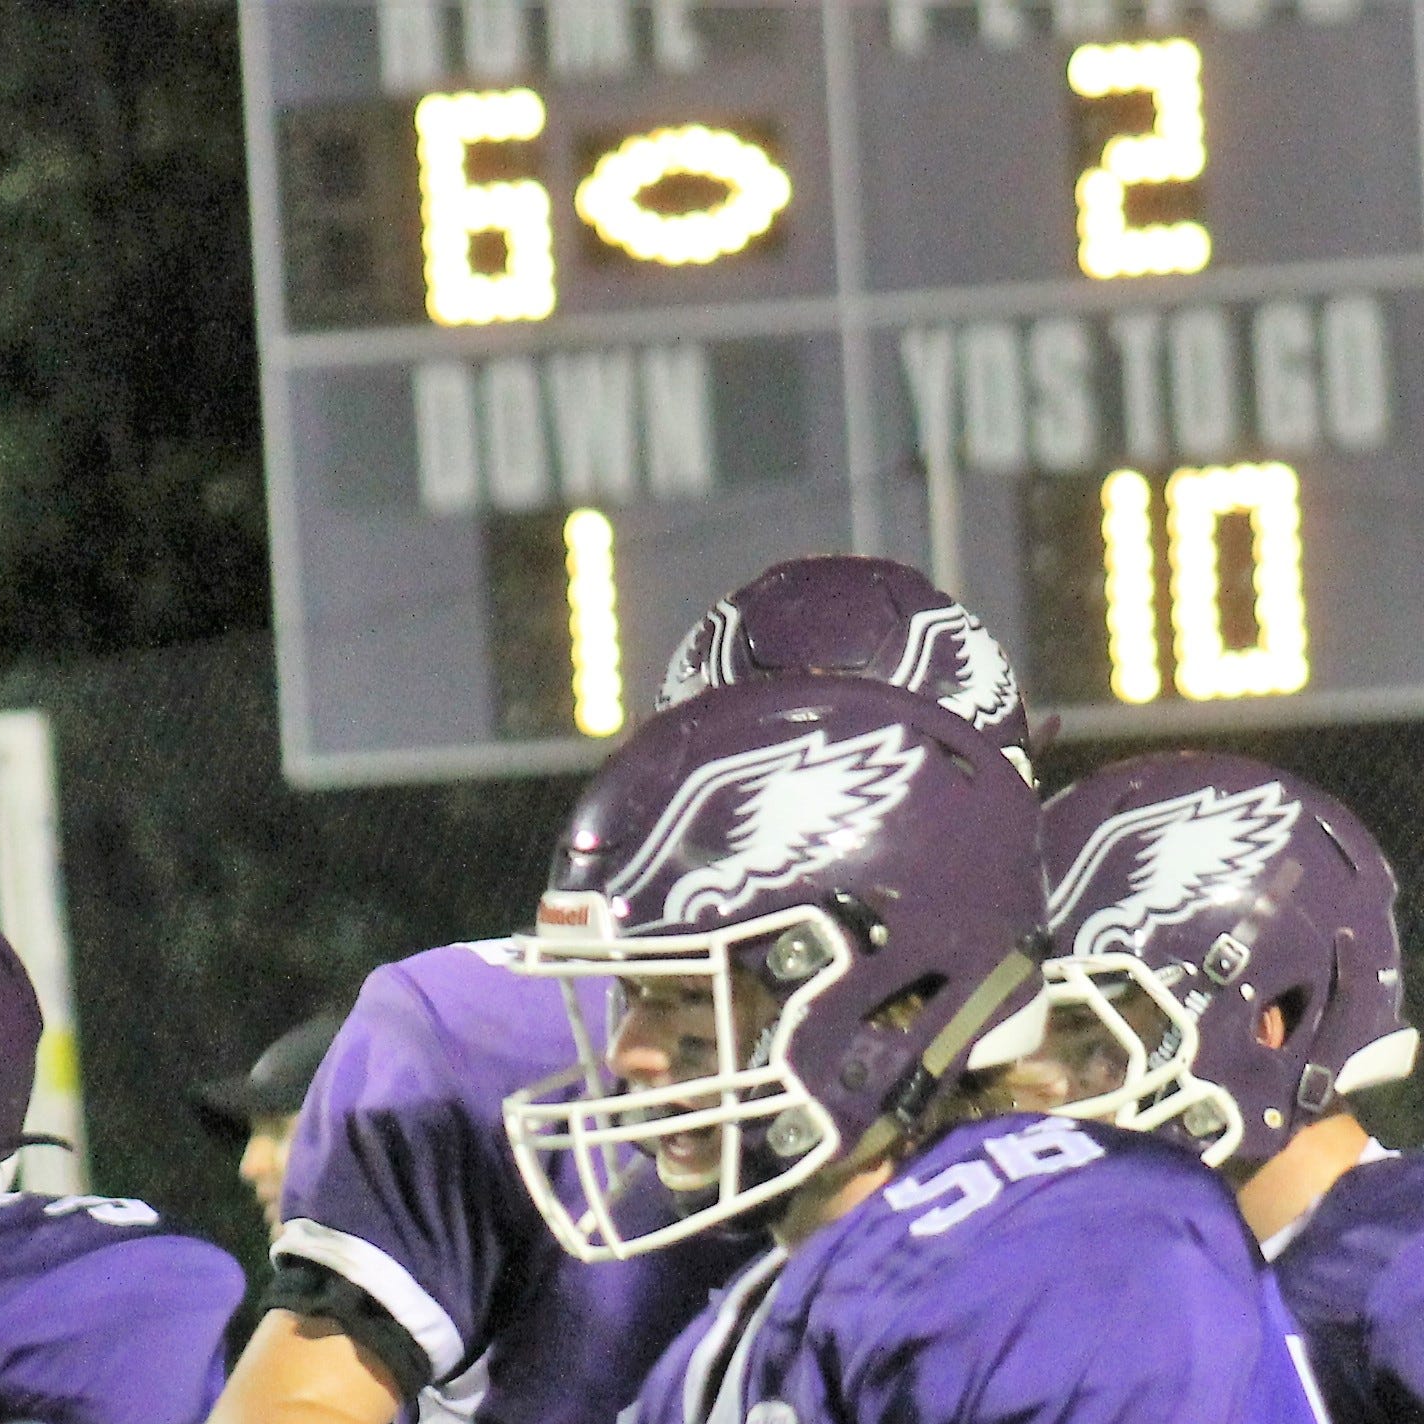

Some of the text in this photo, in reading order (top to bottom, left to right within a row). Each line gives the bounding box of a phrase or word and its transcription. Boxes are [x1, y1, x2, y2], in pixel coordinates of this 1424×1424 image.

[416, 90, 555, 325] 6
[1067, 38, 1211, 279] 2
[416, 348, 713, 514] DOWN
[901, 298, 1388, 470] YDS TO GO
[565, 510, 623, 736] 1
[1103, 463, 1310, 704] 10
[883, 1116, 1106, 1237] 56
